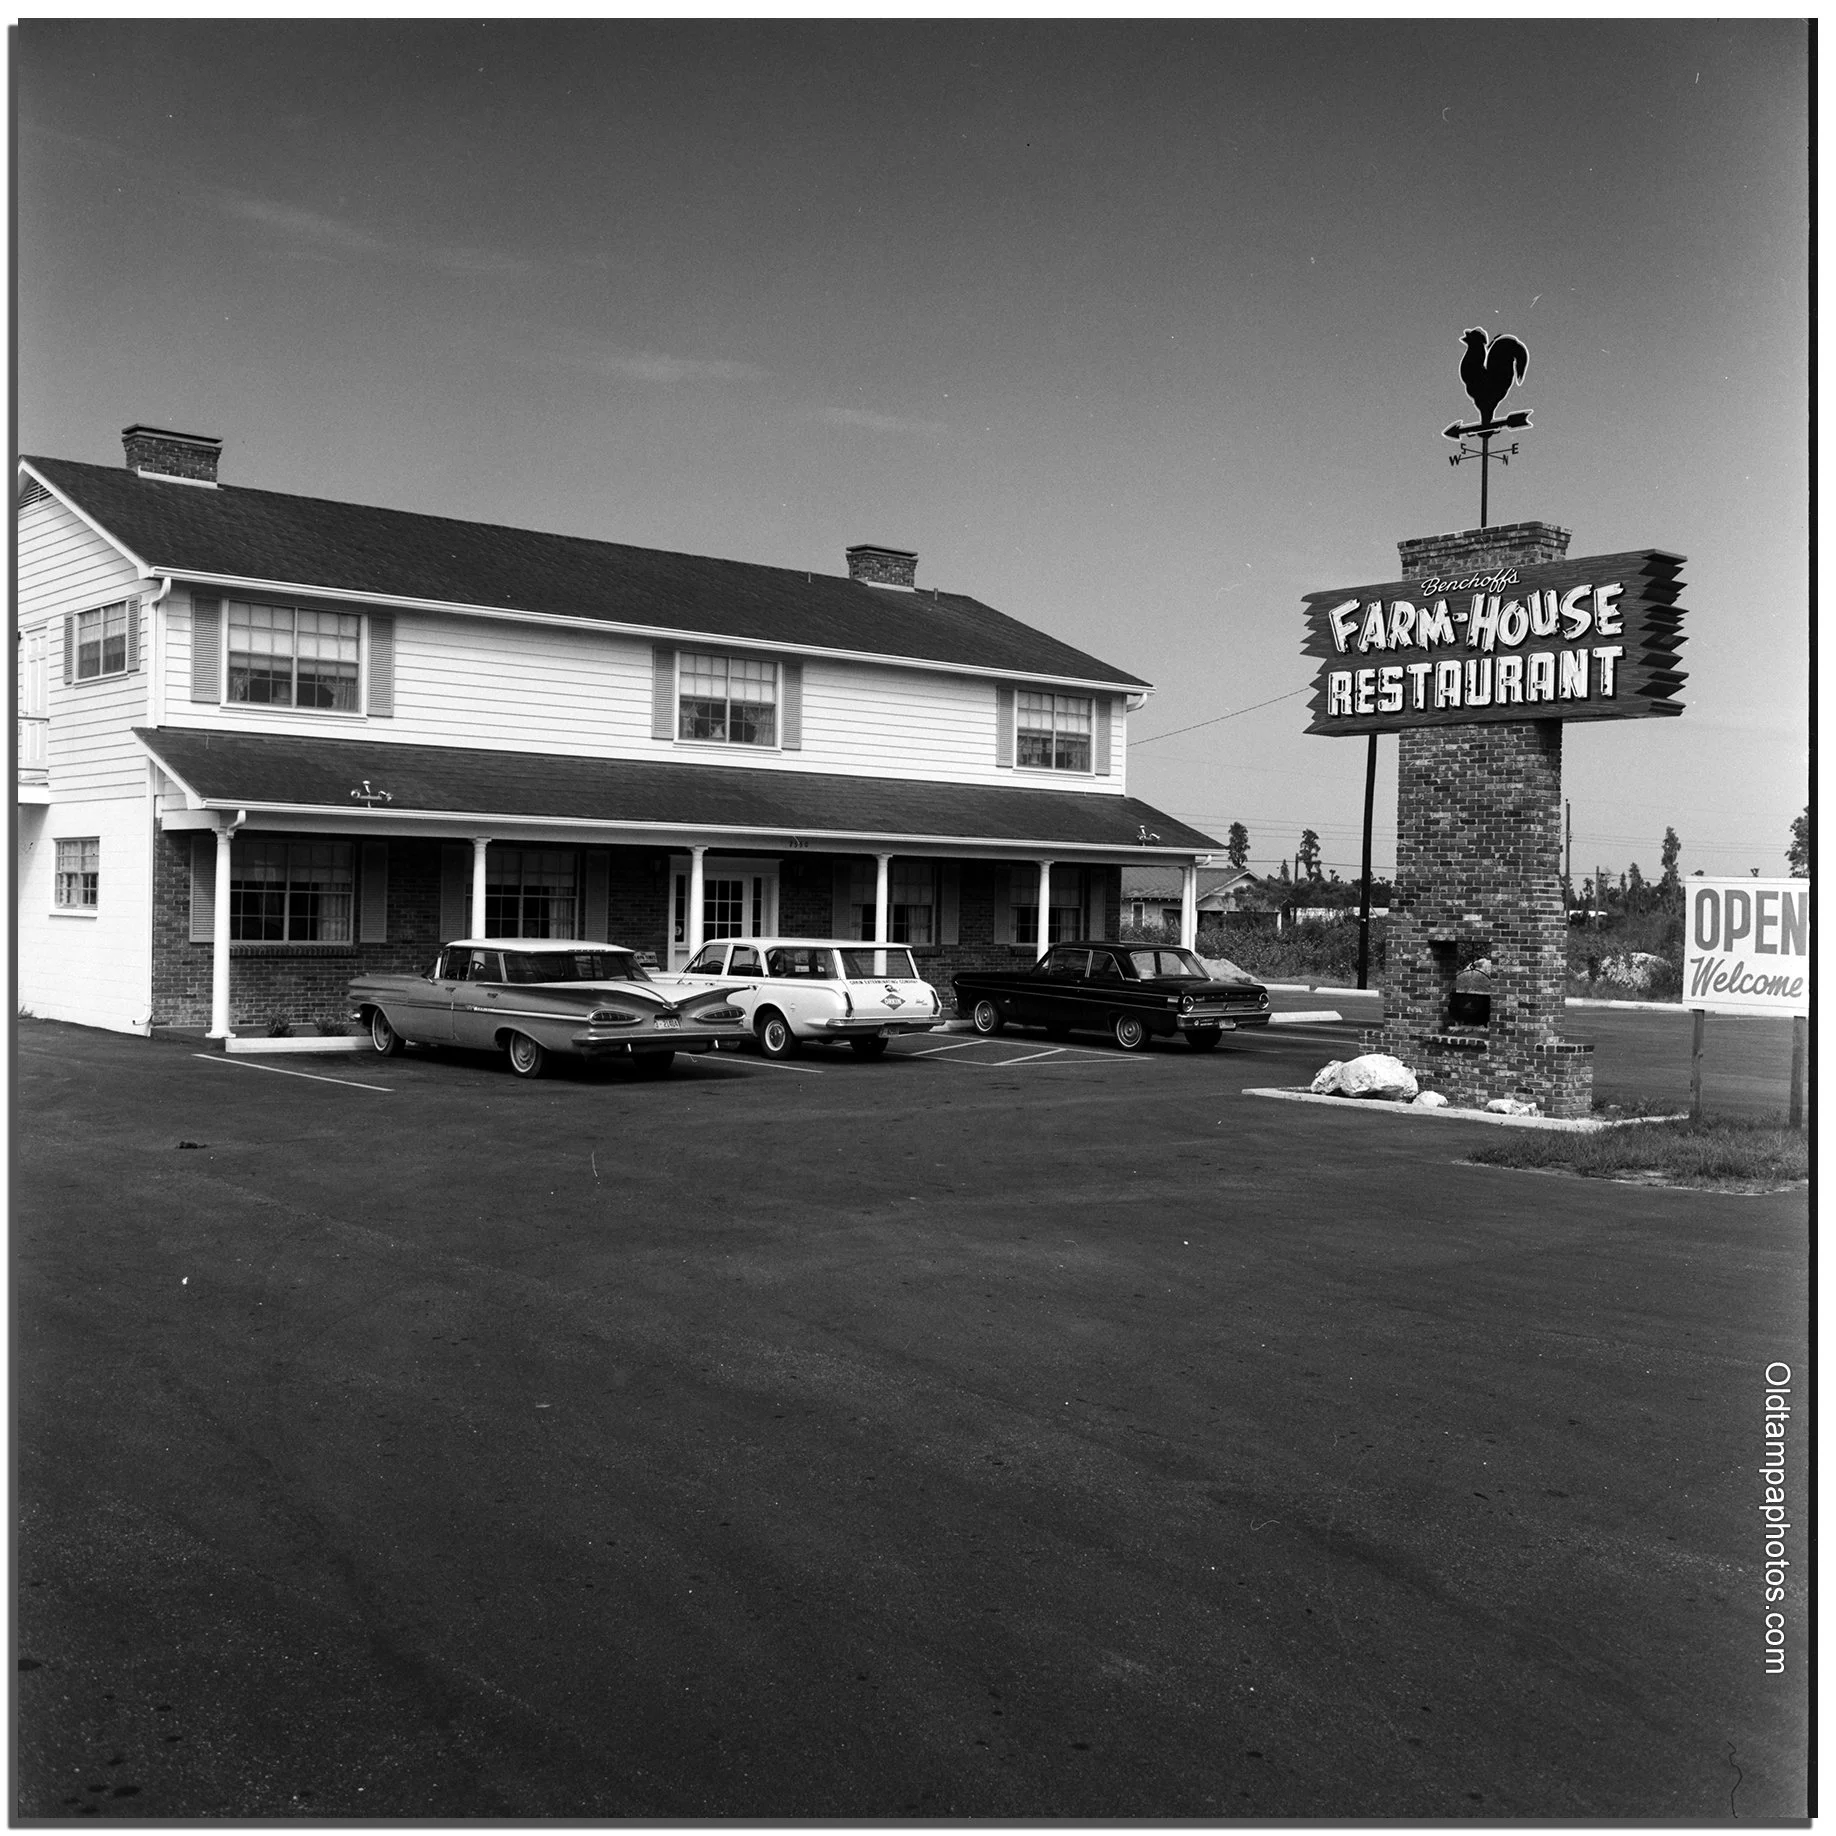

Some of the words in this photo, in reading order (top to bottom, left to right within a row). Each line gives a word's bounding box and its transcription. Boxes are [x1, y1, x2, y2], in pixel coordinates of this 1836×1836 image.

[1449, 454, 1461, 466] W
[1460, 443, 1466, 454] S
[1503, 454, 1508, 465] N
[1512, 443, 1519, 454] E
[1421, 567, 1520, 597] Benchoff's
[1328, 583, 1624, 653] FARM-HOUSE
[1327, 646, 1624, 717] RESTAURANT
[1695, 888, 1808, 956] OPEN
[1690, 957, 1804, 998] Welcome
